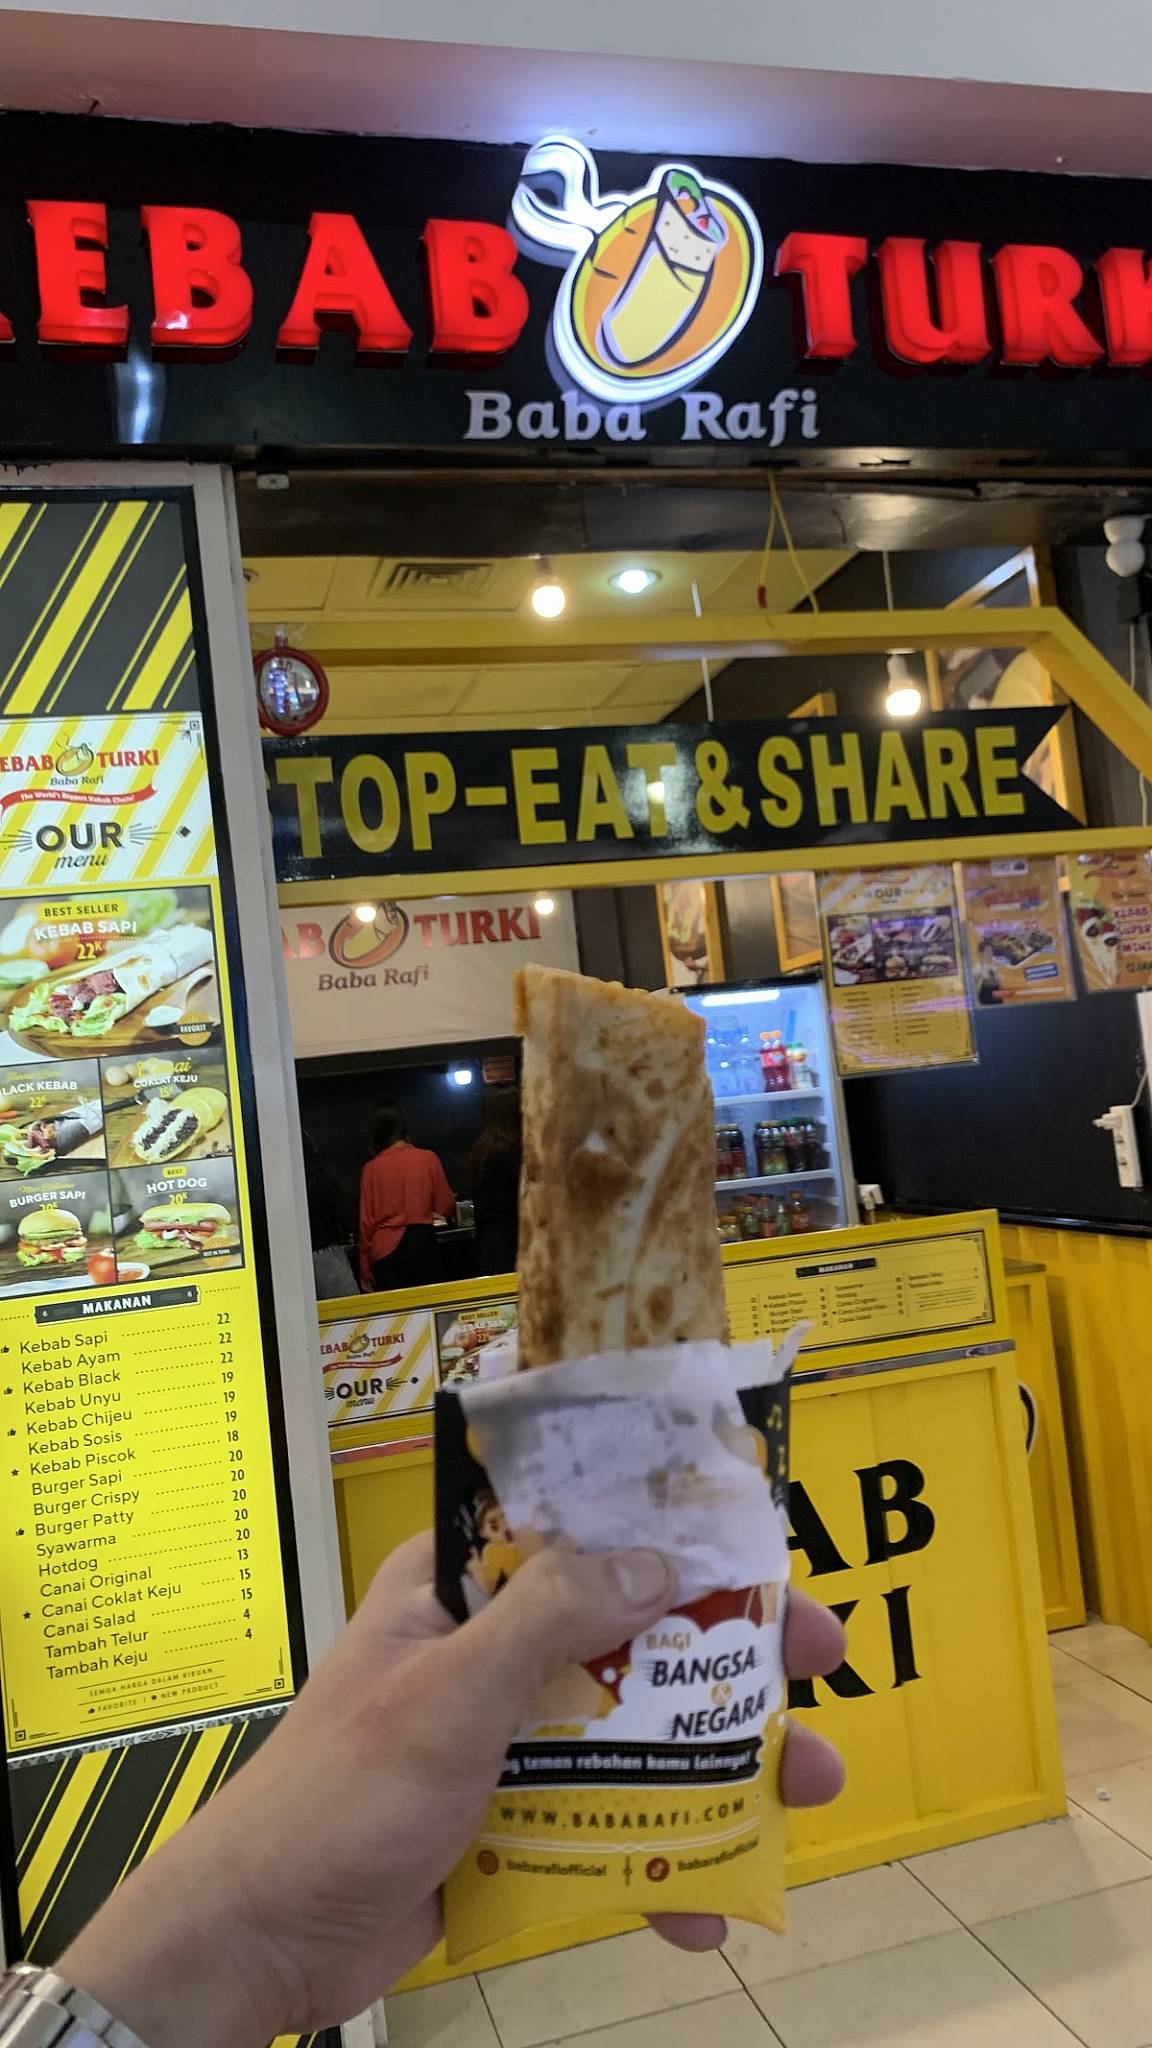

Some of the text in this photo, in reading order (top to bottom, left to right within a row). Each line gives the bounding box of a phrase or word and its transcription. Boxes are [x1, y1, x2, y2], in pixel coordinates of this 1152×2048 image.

[0, 199, 529, 354] EBAB
[462, 388, 821, 447] Baba Rafi
[96, 749, 160, 768] TURKI
[50, 774, 104, 786] Baba Rafi
[36, 821, 124, 852] OUR
[54, 854, 109, 869] menu
[34, 920, 137, 941] KEBAB SAPI
[44, 904, 119, 917] BEST SELLER
[413, 906, 542, 948] TURKI
[318, 965, 429, 991] Baba Rafi
[37, 1081, 78, 1091] KEBAB
[173, 1074, 198, 1083] KEJU
[9, 1191, 86, 1208] BURGER SAPI
[147, 1178, 207, 1194] HOT DOG
[82, 1295, 151, 1314] MAKANAN
[19, 1313, 230, 1355] Kebab Sapi 22
[21, 1332, 232, 1374] Kebab Ayam 22
[371, 1333, 405, 1347] TURKI
[23, 1352, 233, 1394] Kebab Black 22
[25, 1372, 234, 1414] Kebab Unyu 19
[336, 1377, 383, 1399] OUR
[26, 1391, 235, 1435] Kebab Chijeu 19
[28, 1411, 237, 1455] Kebab Sosis 19
[30, 1431, 239, 1475] Kebab Piscok 18
[32, 1450, 243, 1497] Burger Sapi 20
[33, 1469, 245, 1517] Burger Crispy 20
[35, 1489, 247, 1537] Burger Patty 20
[36, 1509, 248, 1558] Syawarma 20
[39, 1528, 250, 1577] Hotdog 20
[40, 1549, 249, 1597] Canai Original 13
[42, 1568, 251, 1618] Canai Coklat Keju 15
[43, 1588, 253, 1638] Canai Salad 15
[45, 1608, 250, 1659] Tambah Telur 4
[46, 1628, 252, 1680] Tambah Keju 4
[646, 1632, 691, 1652] BAGI
[89, 1687, 117, 1698] SEMUA
[120, 1681, 148, 1691] HARGA
[151, 1674, 179, 1685] DALAM
[651, 1646, 756, 1688] BANGSA
[160, 1690, 178, 1699] NEW
[182, 1682, 219, 1695] PRODUCT
[671, 1689, 766, 1740] NEGARA
